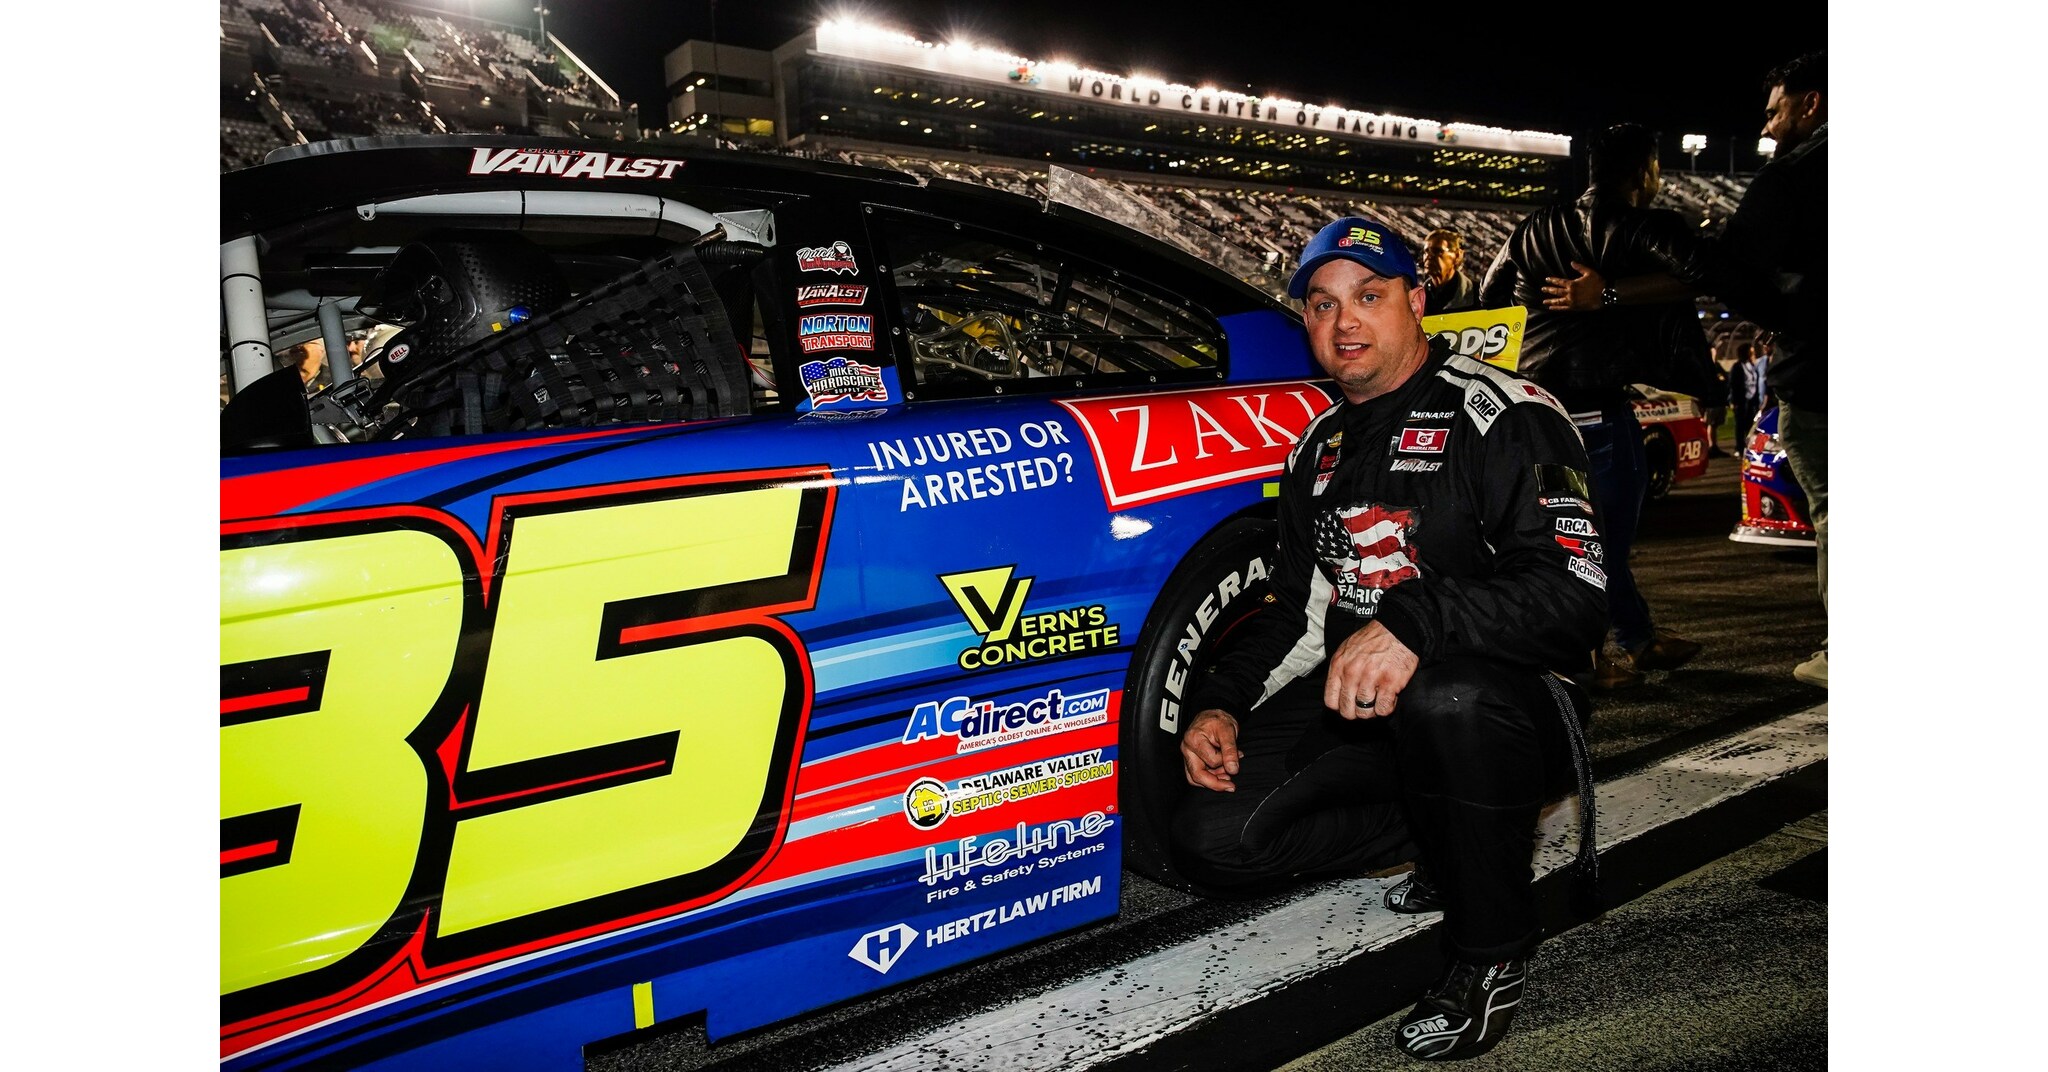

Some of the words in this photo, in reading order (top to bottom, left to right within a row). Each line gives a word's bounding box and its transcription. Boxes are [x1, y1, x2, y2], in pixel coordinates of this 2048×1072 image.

[1068, 76, 1161, 105] WORLD
[1181, 93, 1278, 121] CENTER
[1296, 110, 1321, 127] OF
[1336, 115, 1418, 139] RACING
[1350, 227, 1380, 245] 35
[801, 316, 870, 336] NORTON
[390, 347, 407, 360] BELL
[802, 335, 871, 351] TRANSPORT
[813, 375, 879, 393] HARDSCAPE
[829, 367, 860, 377] MIKE'S
[1410, 410, 1455, 419] MENARDS
[1471, 393, 1498, 417] OMP
[869, 427, 1012, 471] INJURED
[1020, 420, 1071, 449] OR
[900, 453, 1075, 512] ARRESTED?
[1557, 519, 1588, 533] ARCA
[959, 625, 1119, 669] CONCRETE
[1160, 556, 1274, 735] GENERA
[220, 486, 803, 997] 35
[959, 737, 997, 751] AMERICA'S
[998, 731, 1024, 743] OLDEST
[1026, 725, 1051, 737] ONLINE
[1053, 723, 1063, 731] AC
[1064, 714, 1106, 729] WHOLESALER
[1047, 751, 1101, 775] VALLEY
[953, 790, 1003, 815] SEPTIC
[1010, 778, 1057, 800] SEWER
[1065, 762, 1113, 786] STORM
[926, 886, 959, 904] Fire
[964, 879, 977, 890] &
[981, 863, 1034, 886] Safety
[1038, 842, 1105, 869] Systems
[926, 909, 998, 948] HERTZ
[999, 892, 1050, 924] LAW
[1051, 875, 1102, 907] FIRM
[1402, 1018, 1449, 1039] OMP
